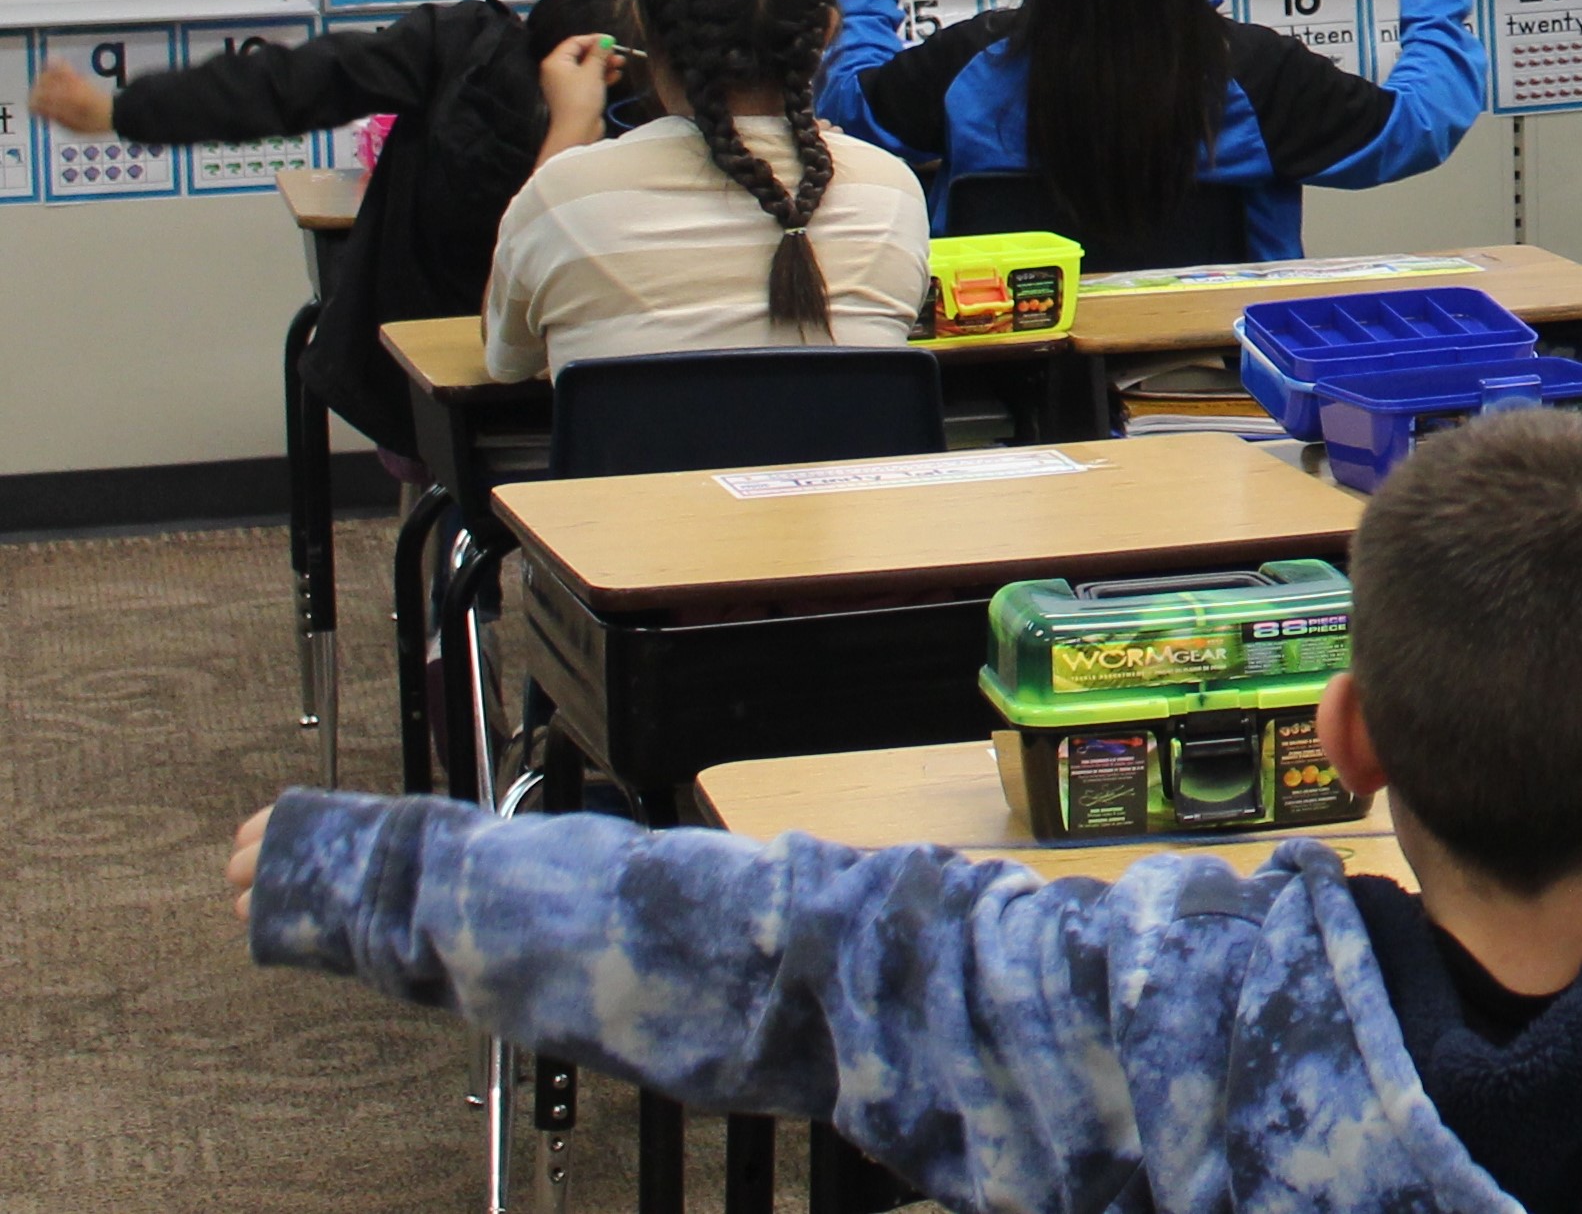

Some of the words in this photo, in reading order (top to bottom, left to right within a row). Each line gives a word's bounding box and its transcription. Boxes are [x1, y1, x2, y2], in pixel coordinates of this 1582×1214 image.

[904, 0, 943, 42] 15
[1291, 25, 1355, 47] hteen
[1253, 618, 1308, 640] 88
[1308, 615, 1348, 626] PIECE
[1308, 624, 1348, 635] PIECE
